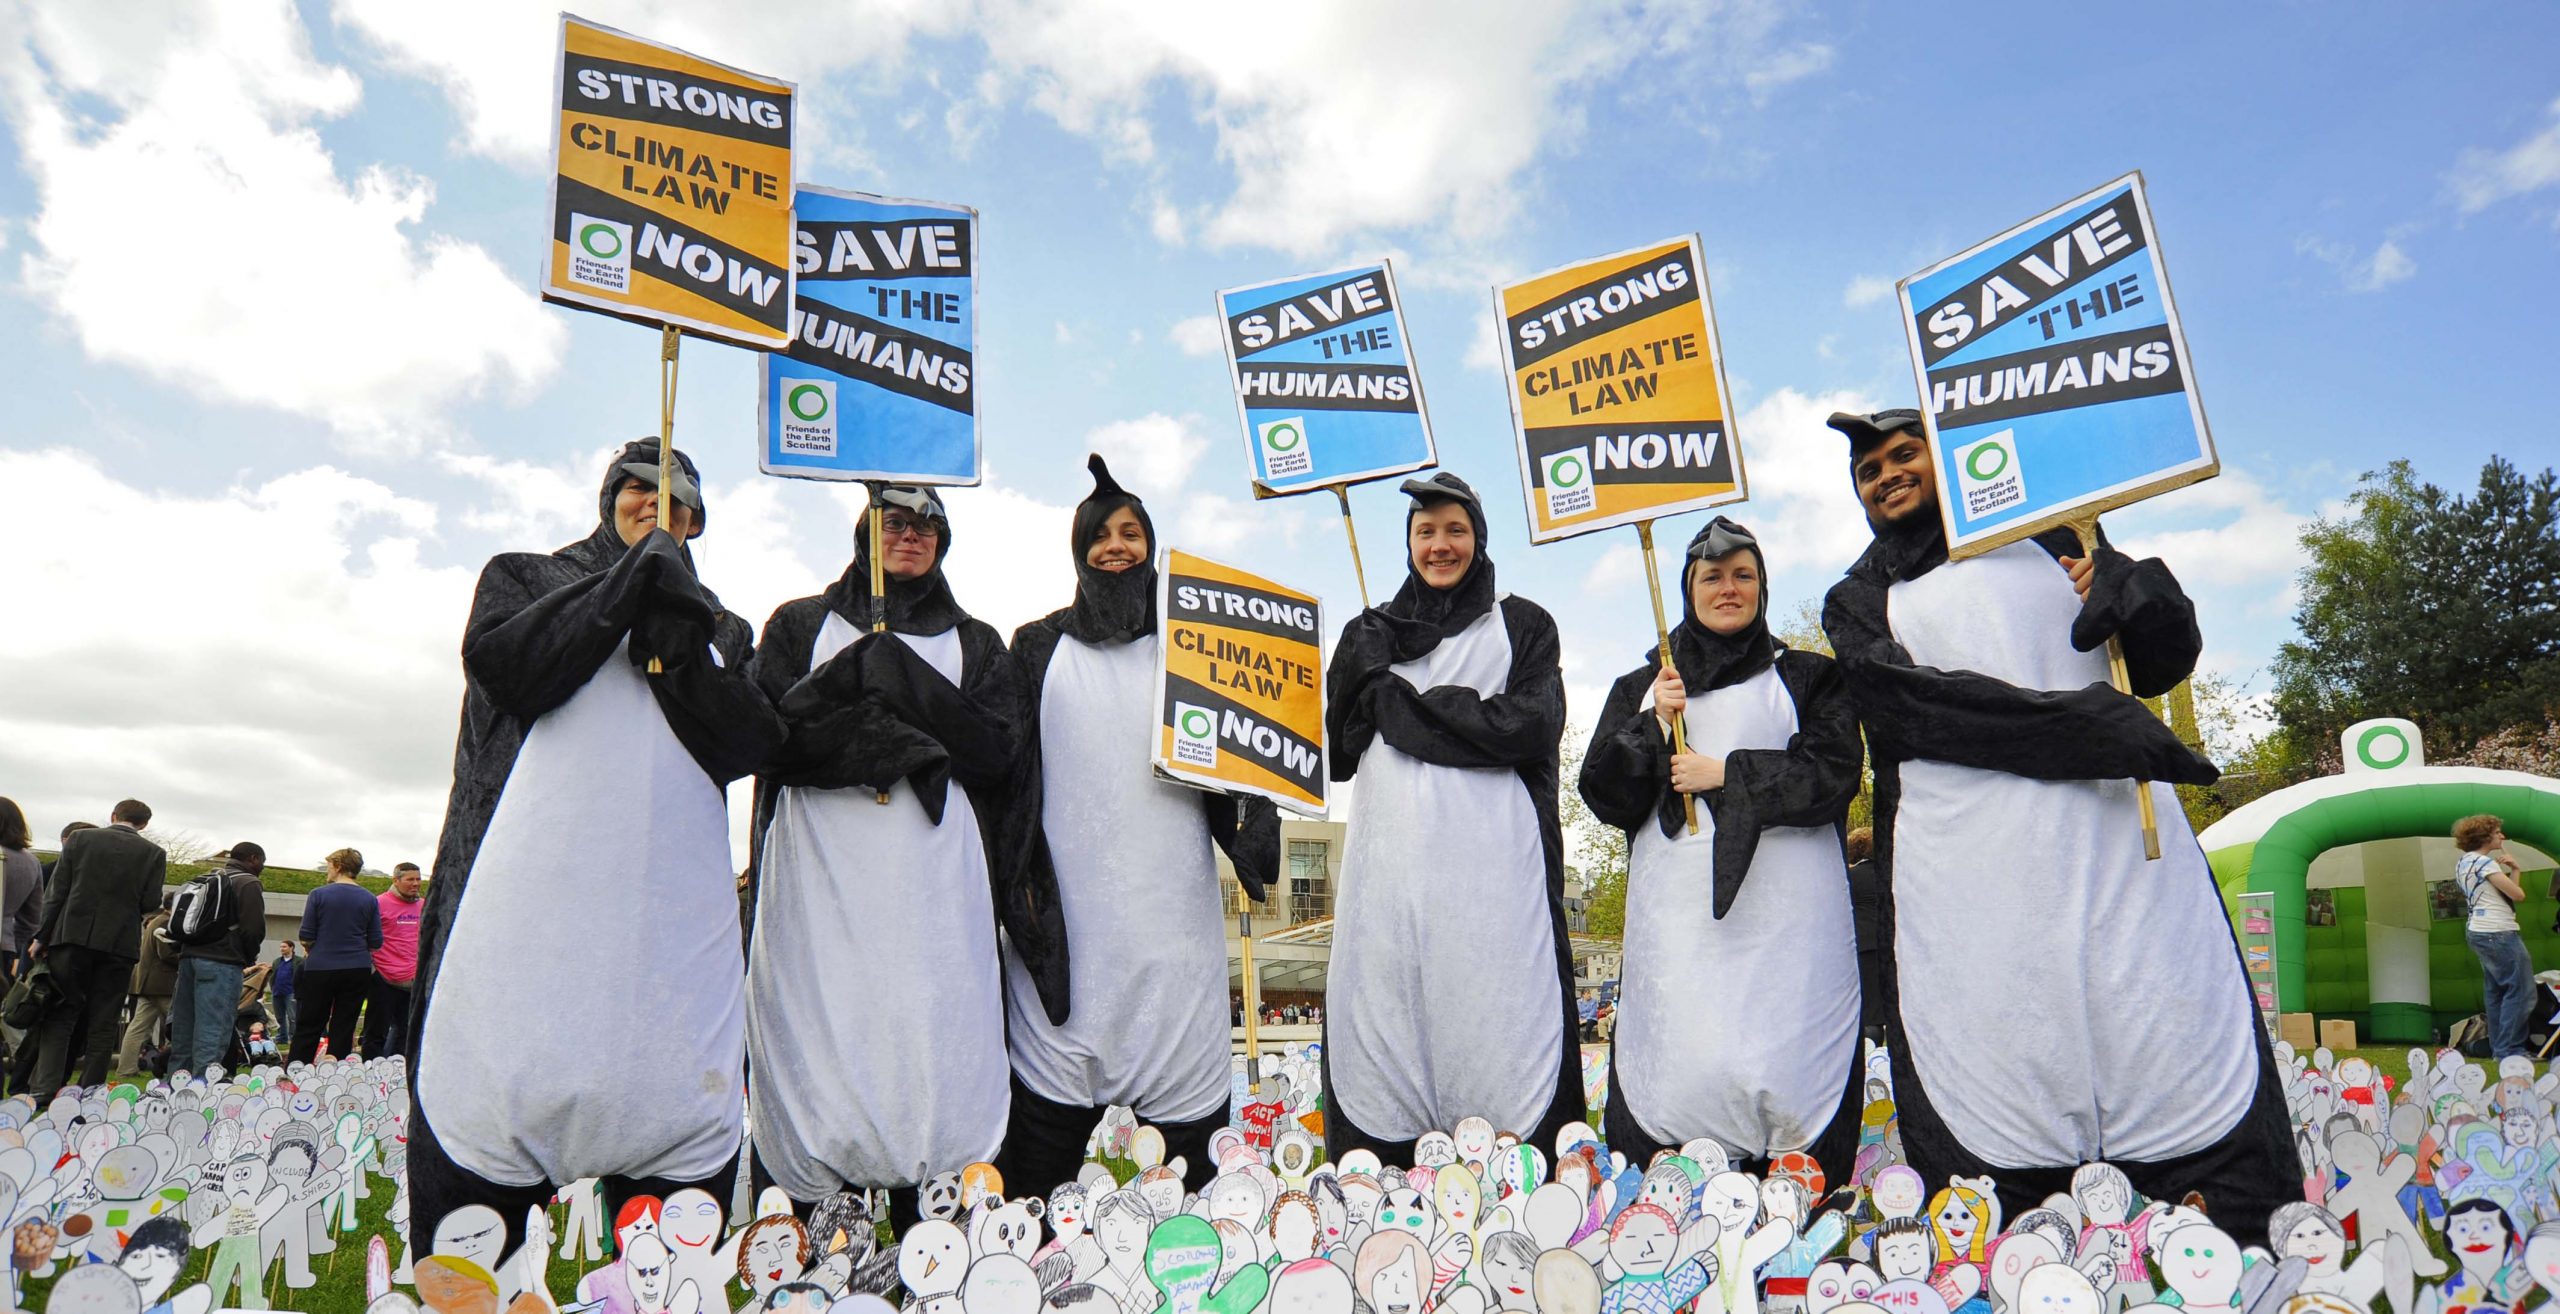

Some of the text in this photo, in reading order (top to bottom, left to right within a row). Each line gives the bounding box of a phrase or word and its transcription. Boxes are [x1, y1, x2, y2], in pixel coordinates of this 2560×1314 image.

[577, 69, 783, 129] STRONG
[570, 122, 777, 201] CLIMATE
[622, 165, 731, 215] LAW
[796, 225, 962, 274] SAVE
[575, 264, 624, 280] the Earth
[576, 257, 612, 271] Friends
[636, 222, 782, 307] NOW
[575, 271, 623, 288] Scotland
[1927, 207, 2132, 350] SAVE
[868, 286, 961, 324] THE
[1238, 277, 1384, 348] SAVE
[1519, 262, 1689, 350] STRONG
[2028, 273, 2144, 341] THE
[1313, 326, 1393, 359] THE
[1524, 333, 1699, 397] CLIMATE
[1240, 371, 1410, 401] HUMANS
[1933, 341, 2171, 414] HUMANS
[1568, 372, 1659, 416] LAW
[786, 424, 820, 434] Friends
[804, 434, 831, 442] Earth
[786, 440, 831, 451] Scotland
[1594, 432, 1719, 470] NOW
[1269, 453, 1297, 463] Friends
[1285, 458, 1307, 466] Earth
[1271, 463, 1308, 475] Scotland
[1552, 490, 1580, 501] Friends
[1968, 475, 2016, 498] Friends of
[1970, 485, 2018, 506] the Earth
[1554, 501, 1591, 515] Scotland
[1567, 495, 1590, 505] Earth
[1971, 492, 2019, 514] Scotland
[1177, 585, 1314, 631] STRONG
[1173, 628, 1314, 689] CLIMATE
[1209, 662, 1283, 701] LAW
[1178, 738, 1204, 749] Friends
[1192, 748, 1212, 757] Earth
[1220, 708, 1318, 778] NOW
[1178, 751, 1212, 763] Scotland
[1248, 1104, 1275, 1122] ACT
[1246, 1122, 1272, 1137] NOW!
[208, 1162, 226, 1172] CAP
[271, 1166, 310, 1178] INCLUDE
[300, 1180, 332, 1201] SHIPS
[1873, 1291, 1919, 1307] THIS
